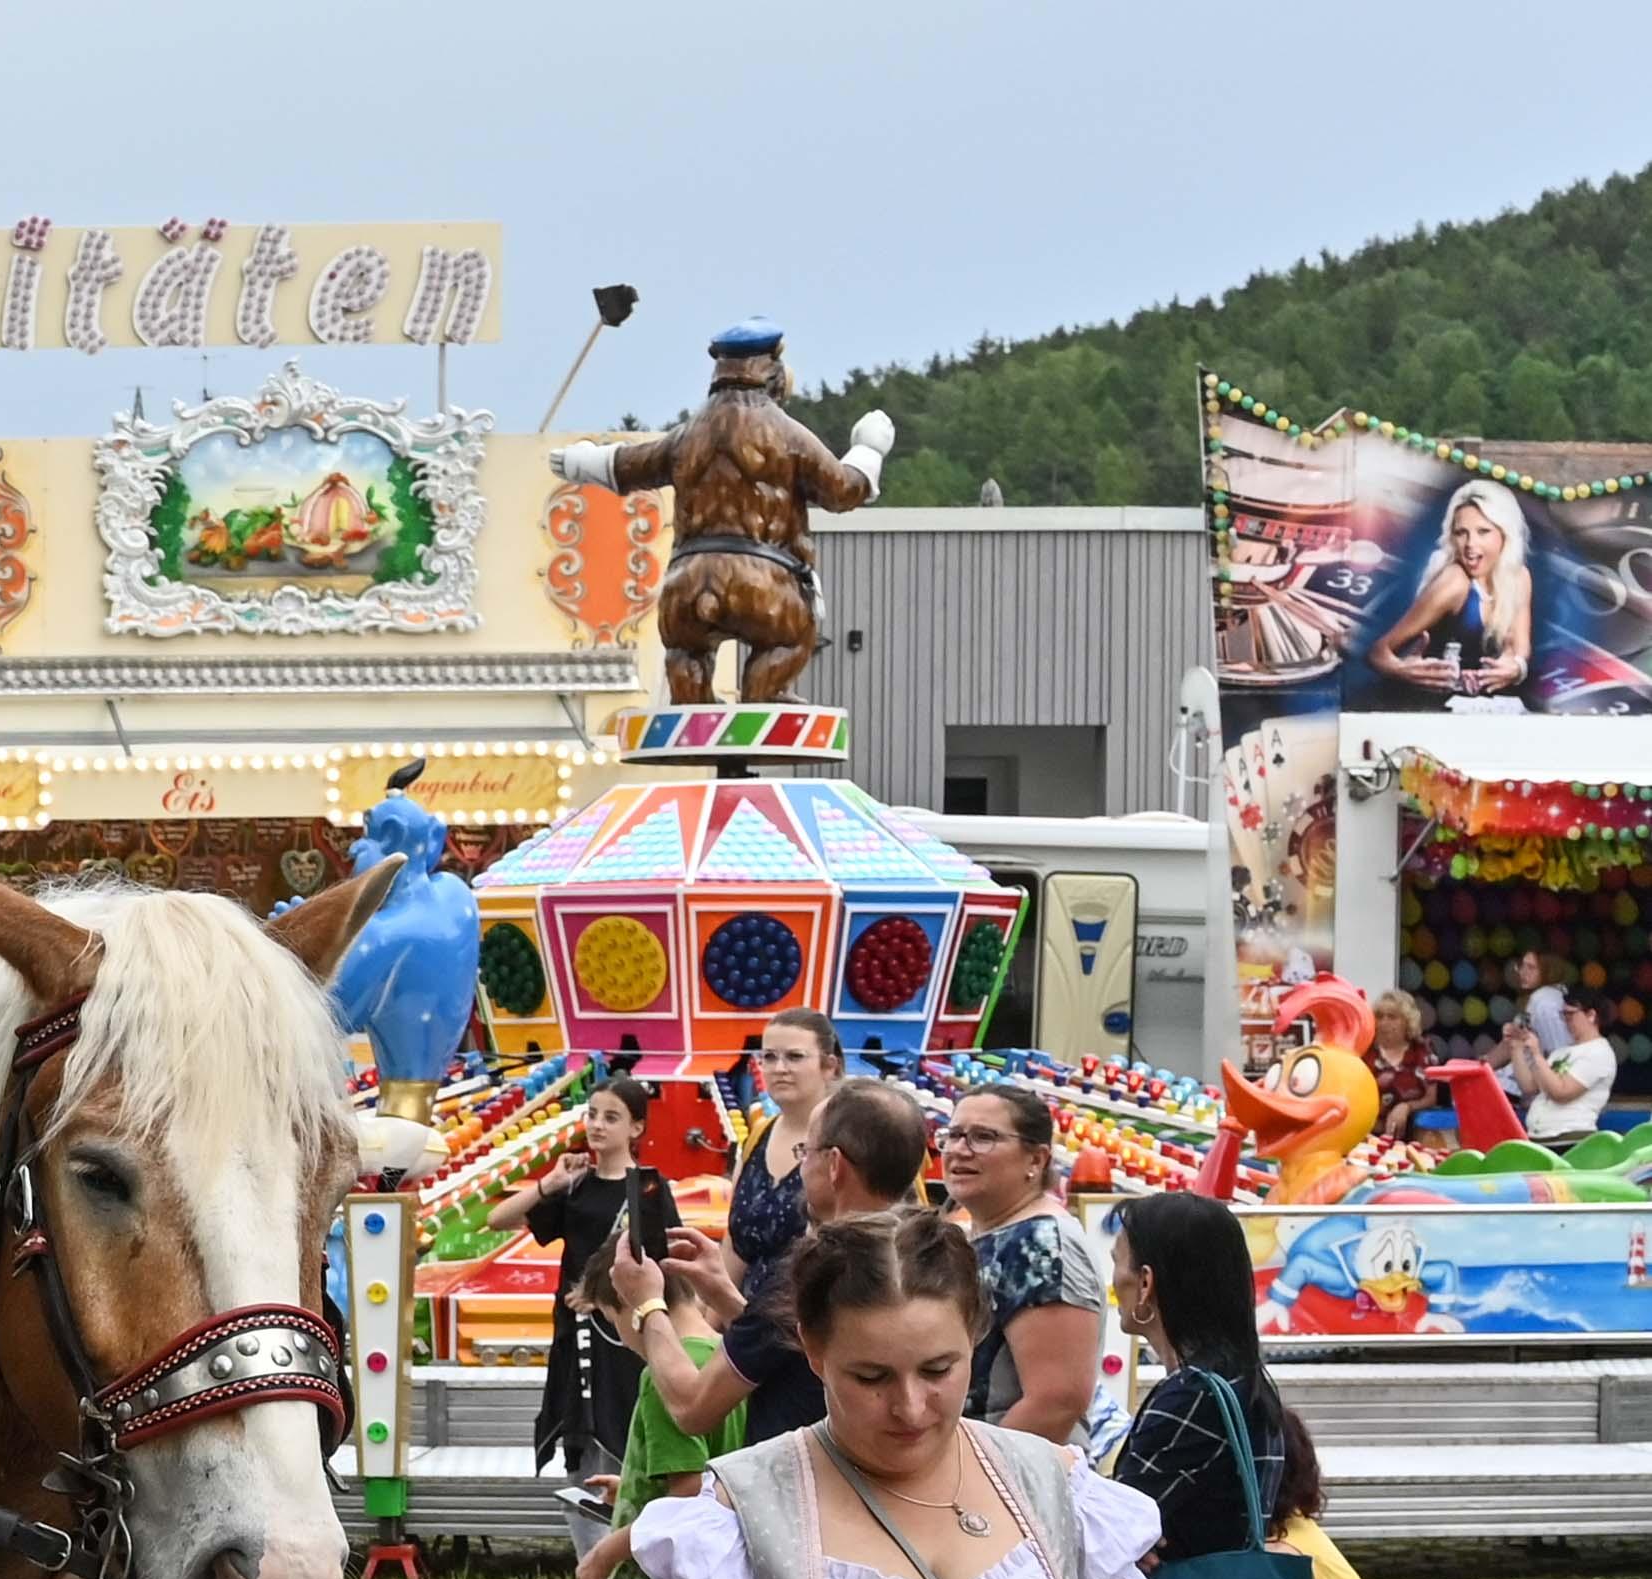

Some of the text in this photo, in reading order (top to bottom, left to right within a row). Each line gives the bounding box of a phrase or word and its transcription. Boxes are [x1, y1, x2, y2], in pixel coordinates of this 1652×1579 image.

[1326, 568, 1373, 597] 33
[1539, 666, 1585, 692] 14
[1270, 729, 1283, 748] A
[1253, 744, 1266, 762] A
[161, 771, 216, 814] Eis
[407, 770, 518, 804] agenbrot
